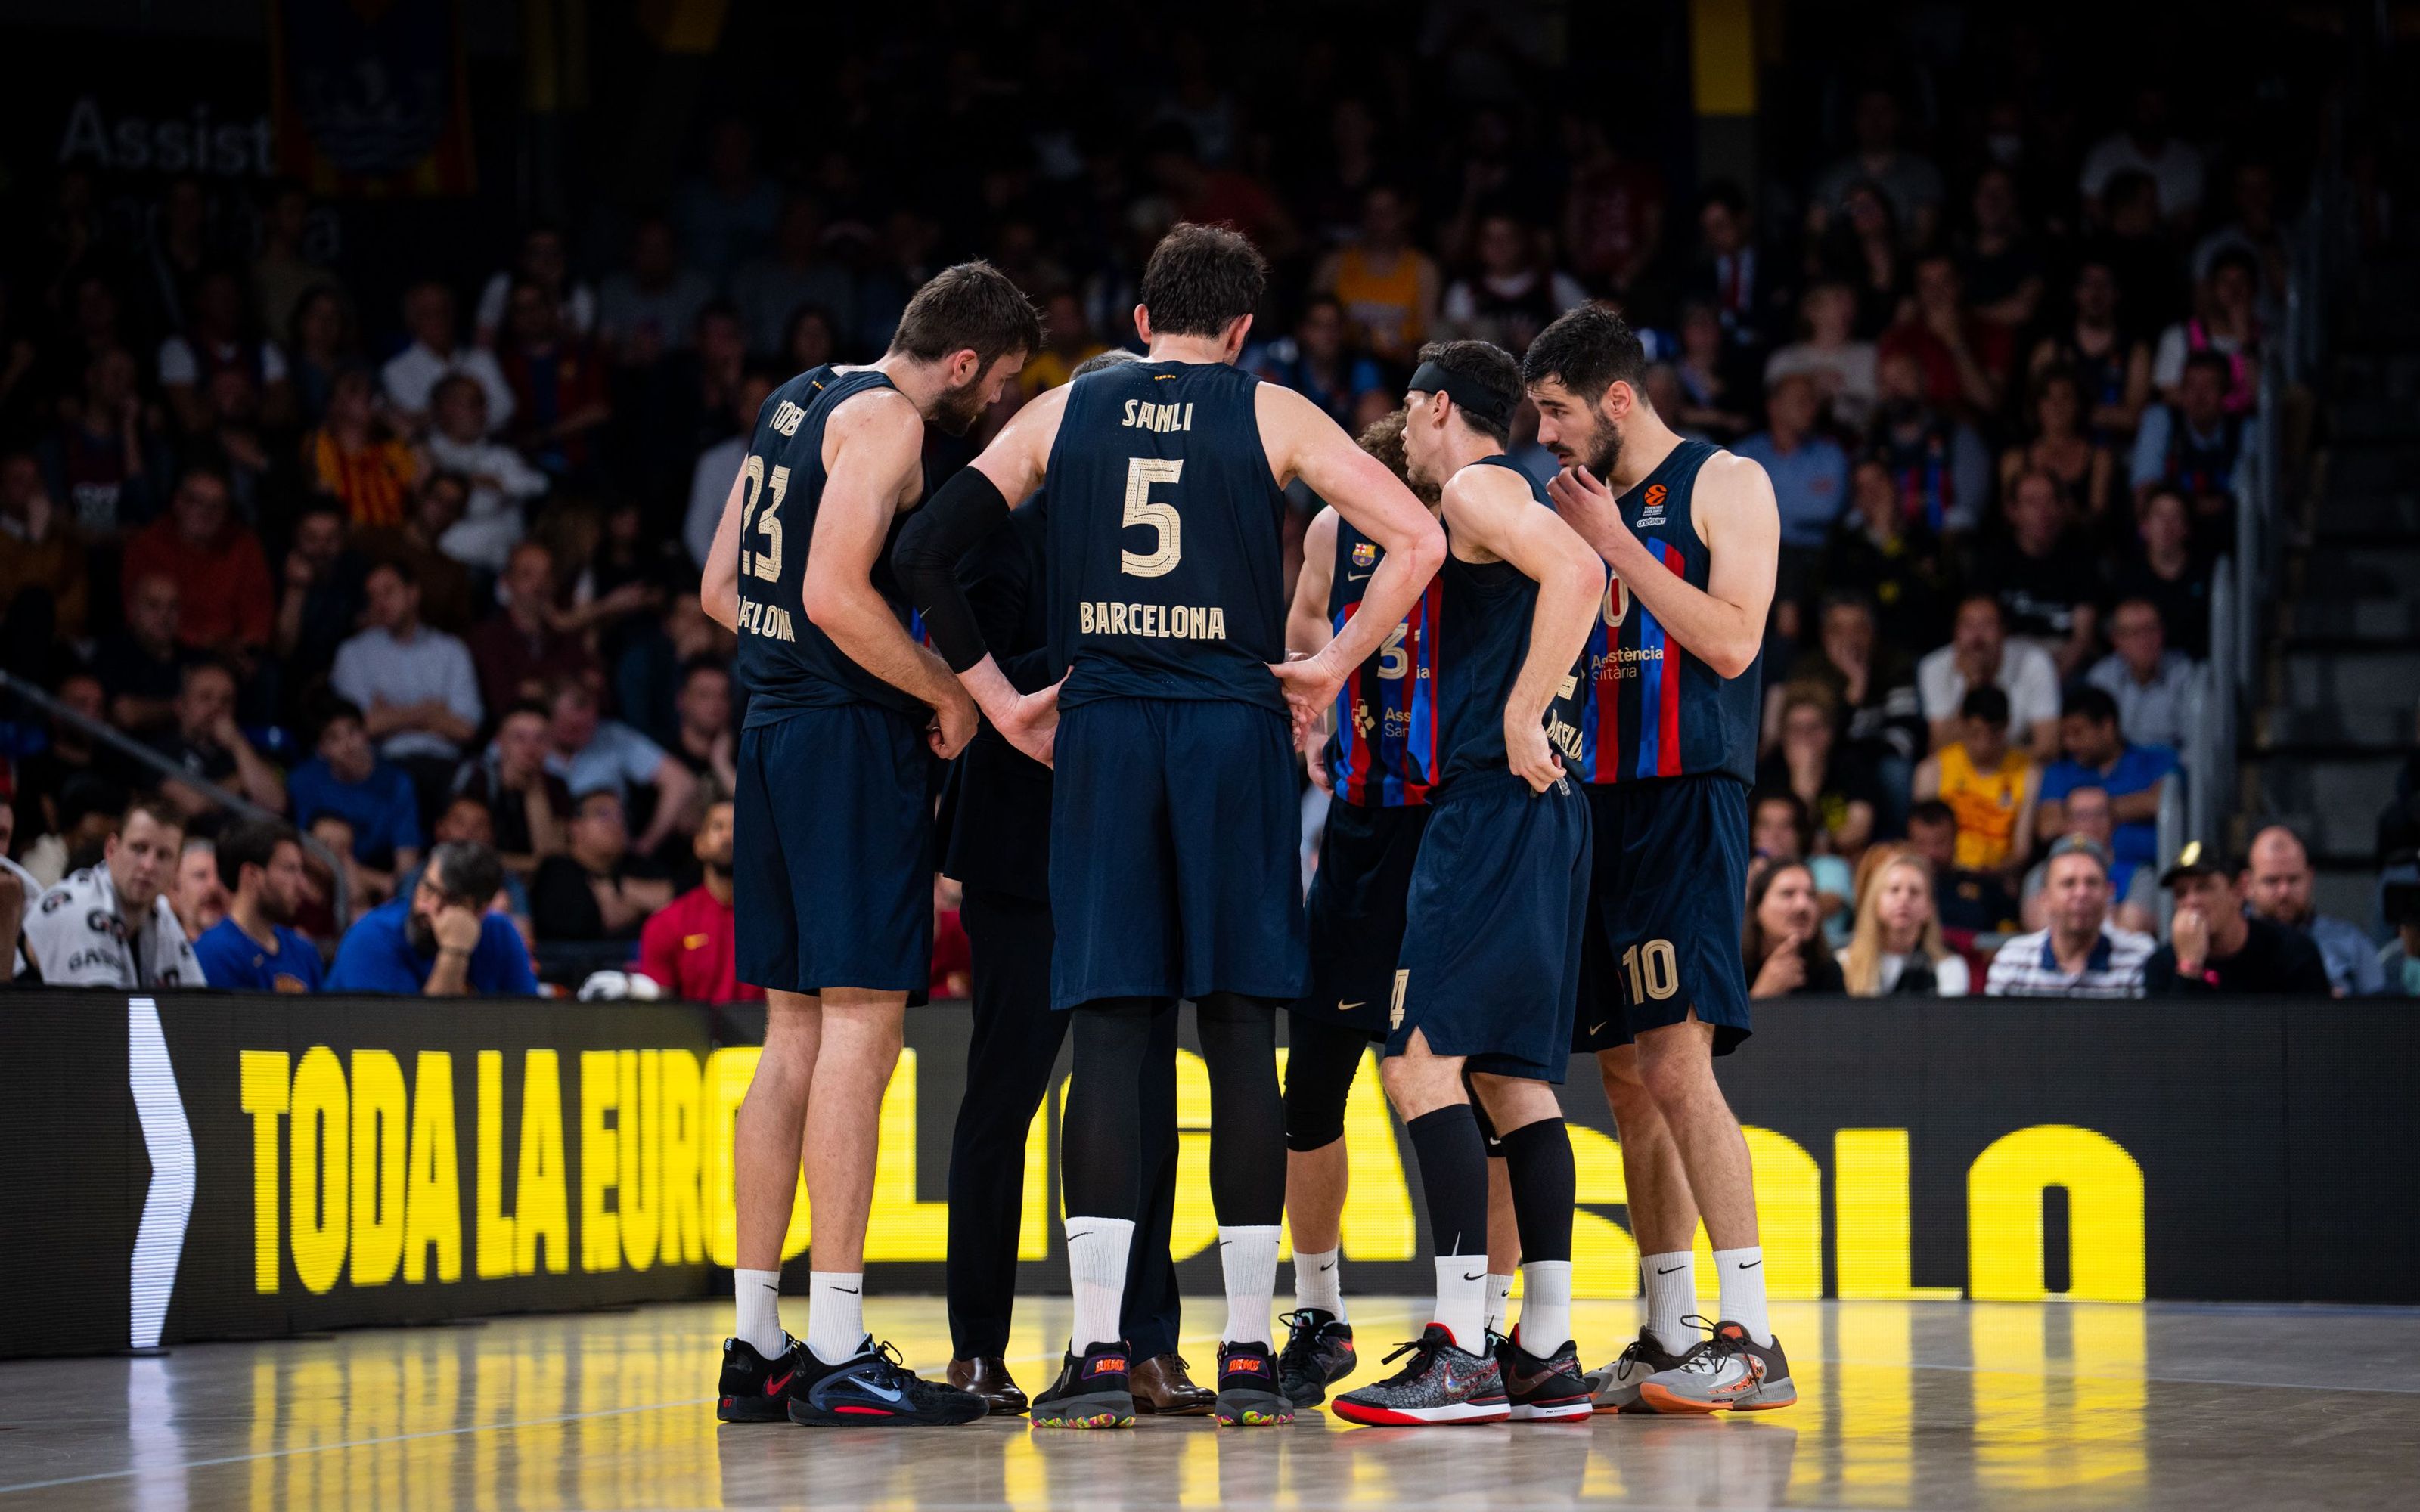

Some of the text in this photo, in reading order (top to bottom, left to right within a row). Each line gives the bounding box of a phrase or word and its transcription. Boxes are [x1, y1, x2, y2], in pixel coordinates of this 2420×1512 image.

[1122, 398, 1193, 432] SANLI
[742, 455, 791, 583] 23
[1121, 457, 1184, 578] 5
[1079, 601, 1226, 640] BARCELONA
[1622, 939, 1680, 1005] 10
[240, 1045, 462, 1295] TODA
[476, 1049, 569, 1280] LA
